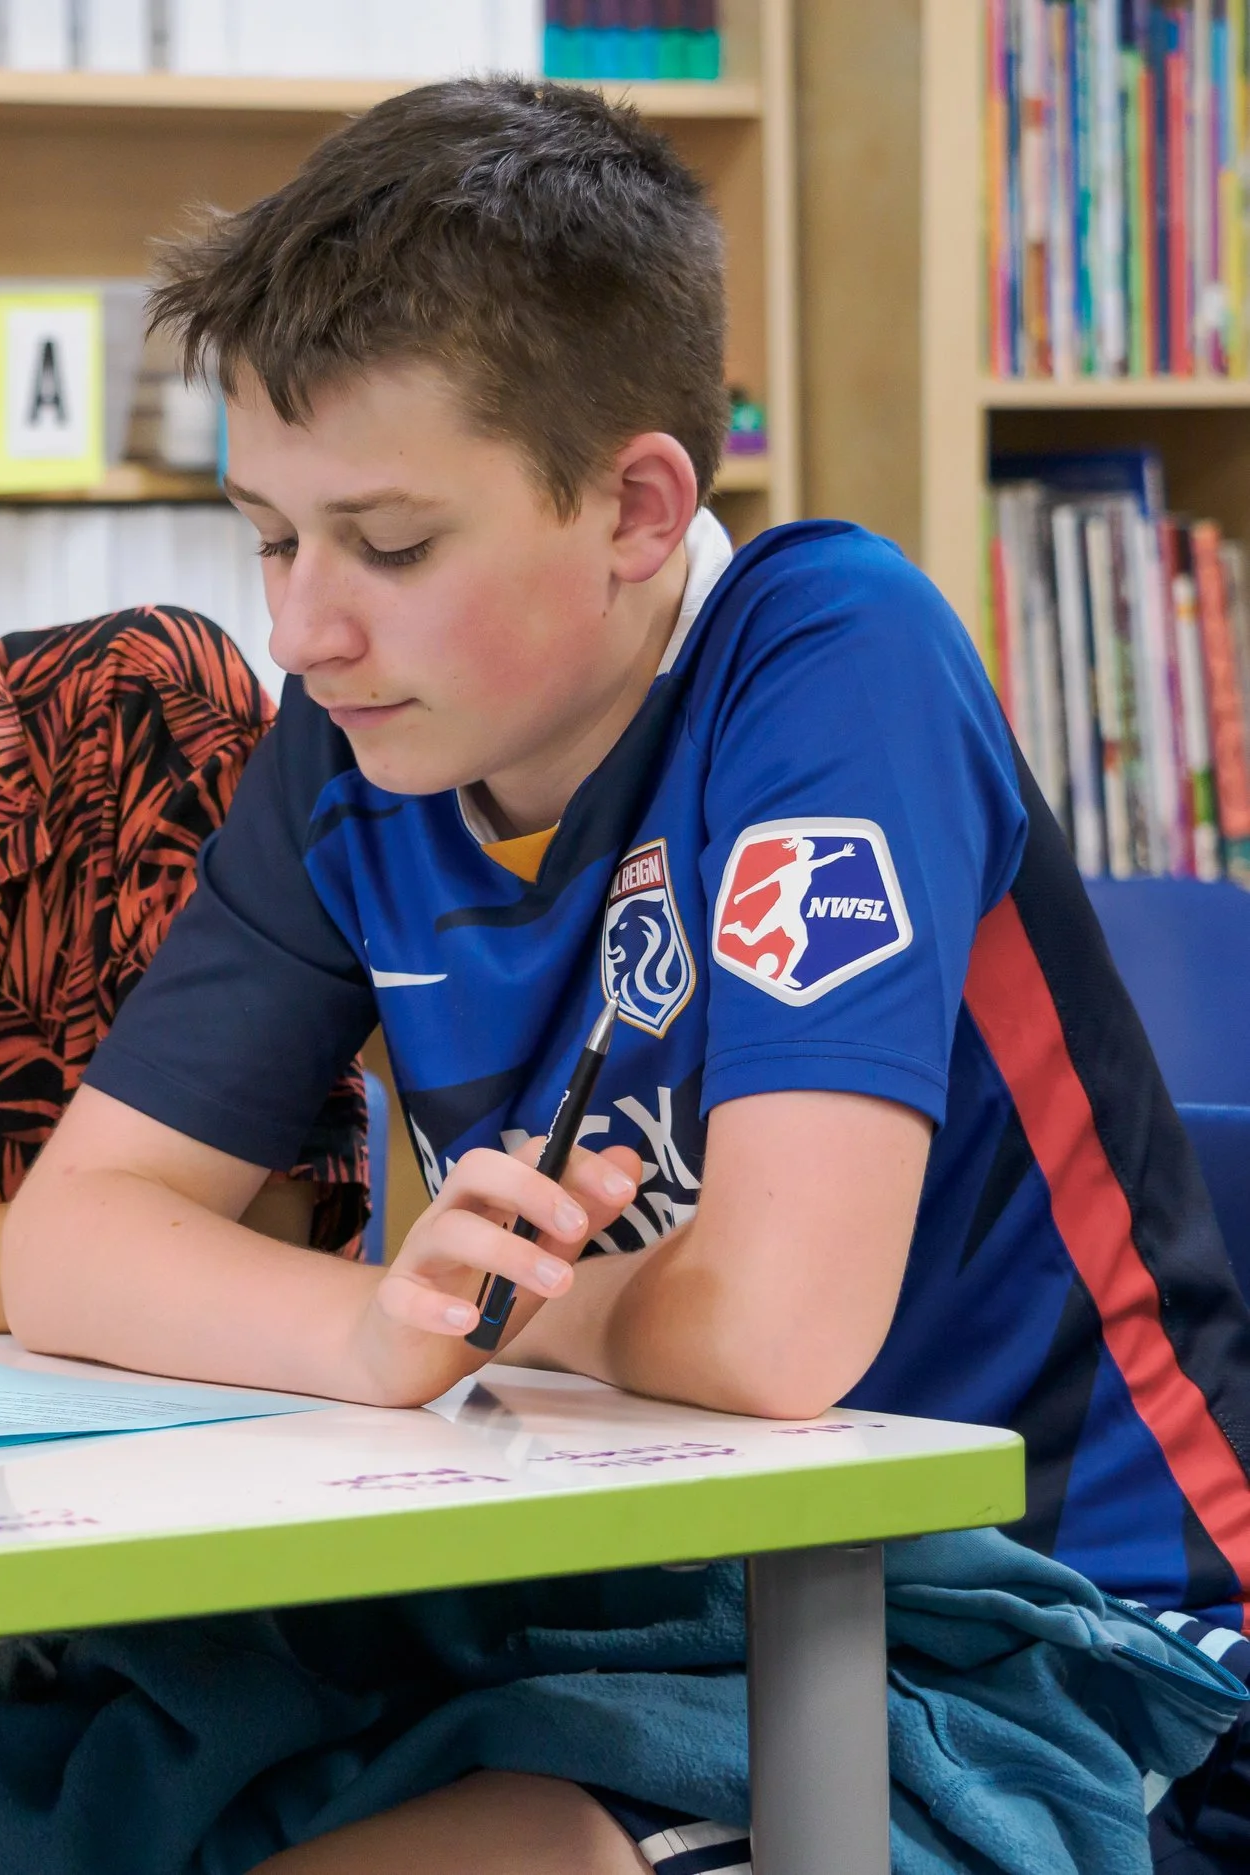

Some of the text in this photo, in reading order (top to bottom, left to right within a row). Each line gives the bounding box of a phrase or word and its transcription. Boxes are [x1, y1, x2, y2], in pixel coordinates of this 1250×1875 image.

[24, 337, 70, 426] A
[621, 855, 662, 892] REIGN
[806, 897, 888, 922] NWSL
